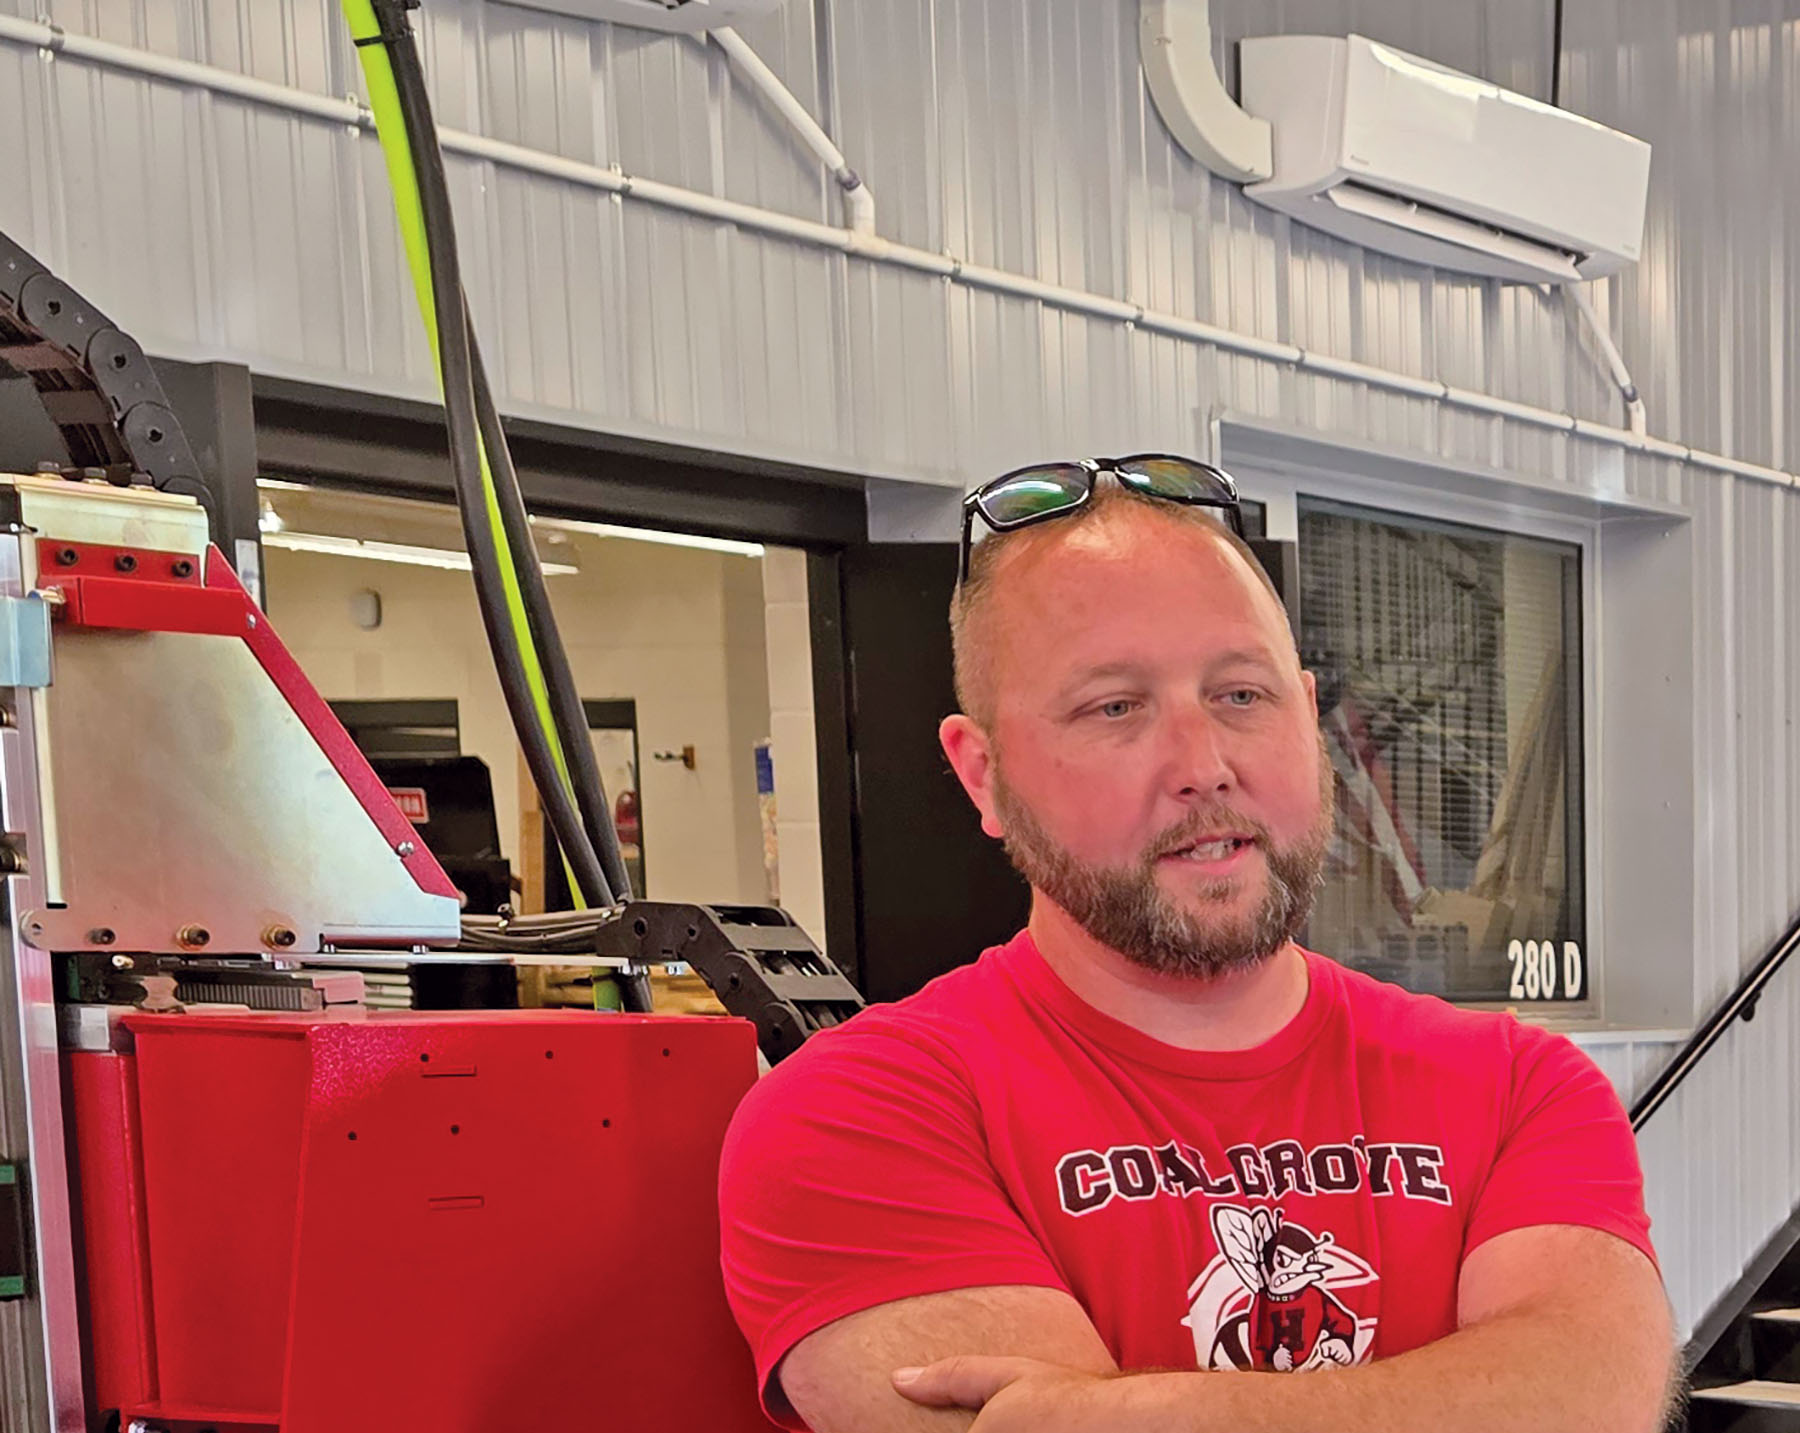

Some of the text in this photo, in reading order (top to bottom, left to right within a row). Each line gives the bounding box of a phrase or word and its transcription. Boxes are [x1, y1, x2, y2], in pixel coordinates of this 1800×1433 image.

[1508, 939, 1582, 1000] 280 D
[1270, 1308, 1306, 1352] H
